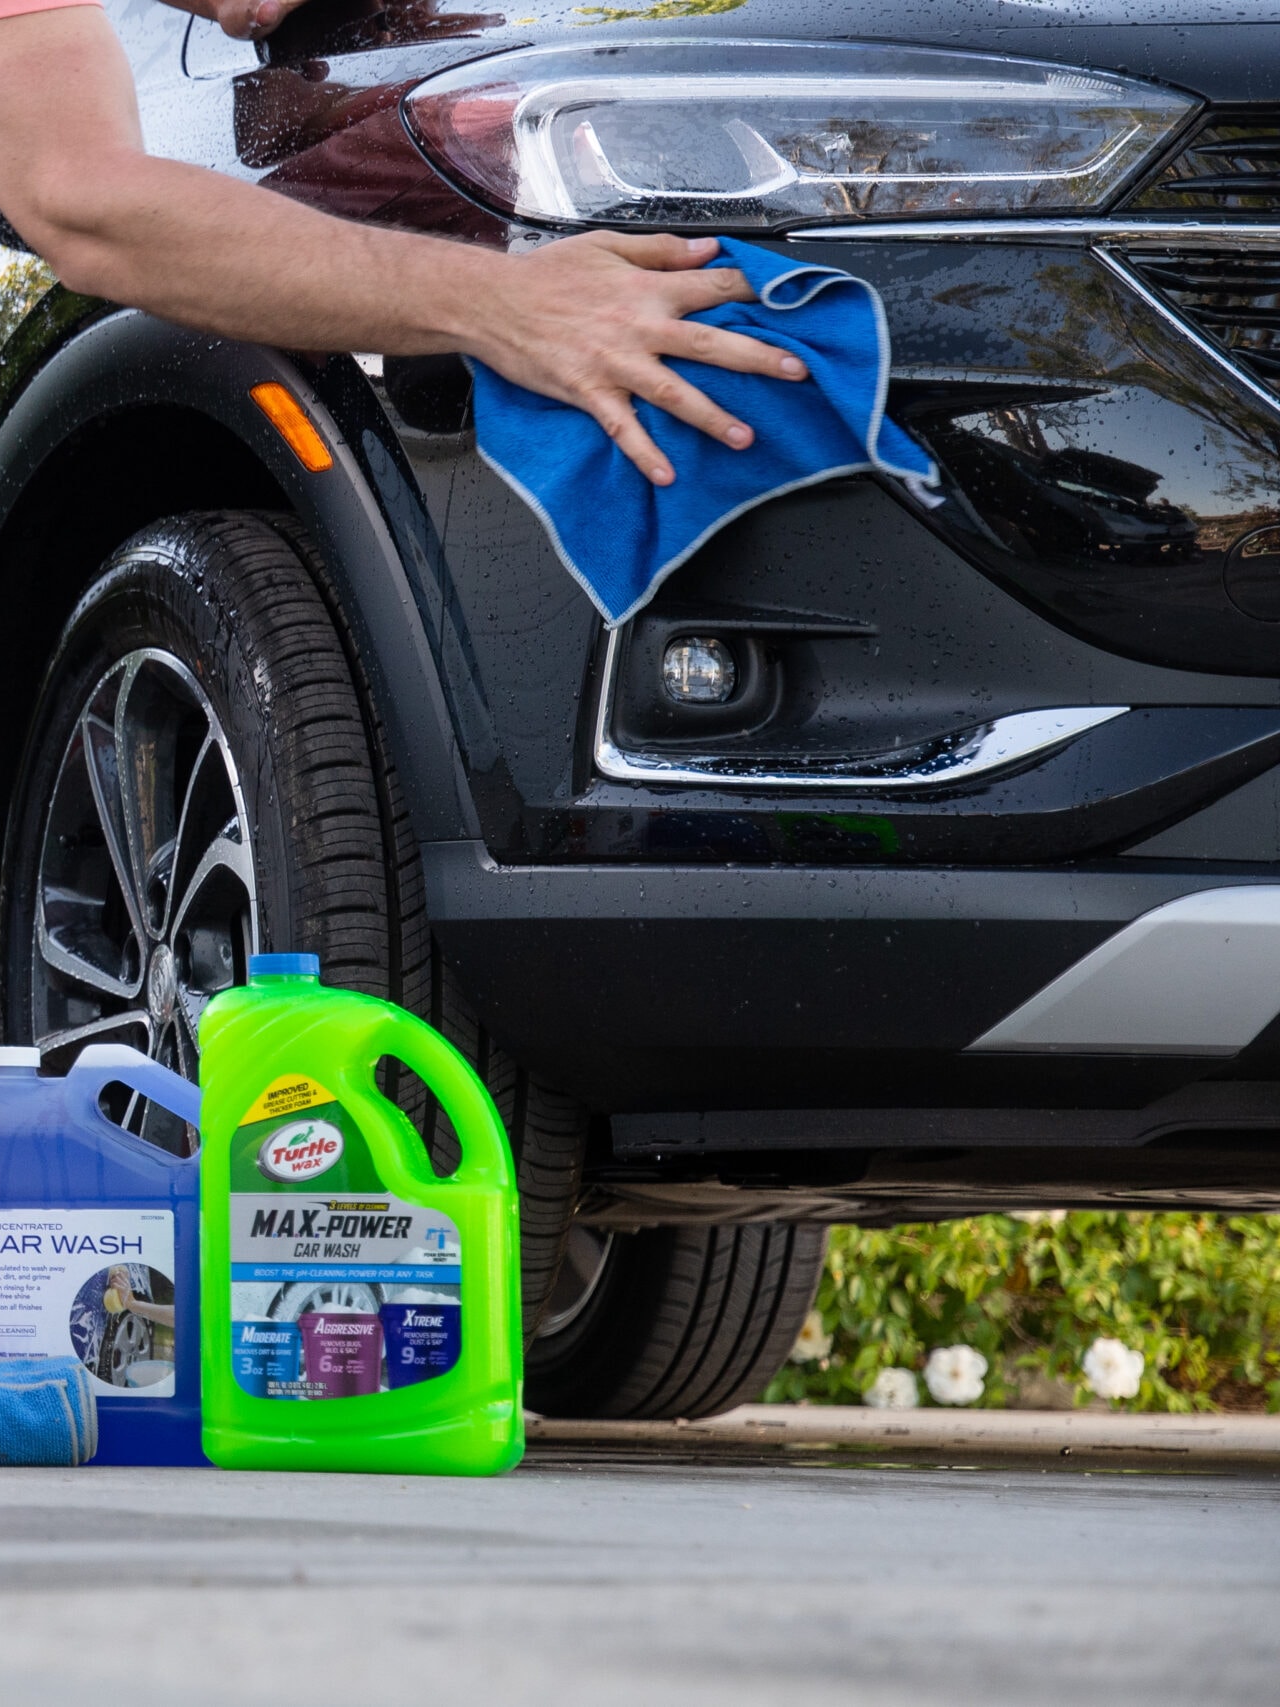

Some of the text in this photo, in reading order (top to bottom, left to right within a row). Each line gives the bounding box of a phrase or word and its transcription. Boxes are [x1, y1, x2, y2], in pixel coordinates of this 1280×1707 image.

[267, 1082, 309, 1100] IMPROVED
[263, 1098, 286, 1109] GREASE
[286, 1091, 312, 1103] CUTTING
[269, 1099, 312, 1114] THICKER FOAM
[272, 1138, 338, 1165] Turtle
[291, 1157, 322, 1172] wax
[329, 1200, 337, 1210] 3
[50, 1235, 142, 1255] WASH
[293, 1243, 361, 1258] CAR WASH
[3, 1273, 17, 1281] dirt,
[254, 1269, 279, 1277] BOOST
[281, 1269, 295, 1277] THE
[348, 1269, 377, 1278] POWER
[378, 1270, 395, 1278] FOR
[396, 1270, 414, 1279] ANY
[415, 1270, 435, 1279] TASK
[3, 1284, 25, 1292] rinsing
[10, 1303, 18, 1311] all
[18, 1303, 43, 1311] finishes
